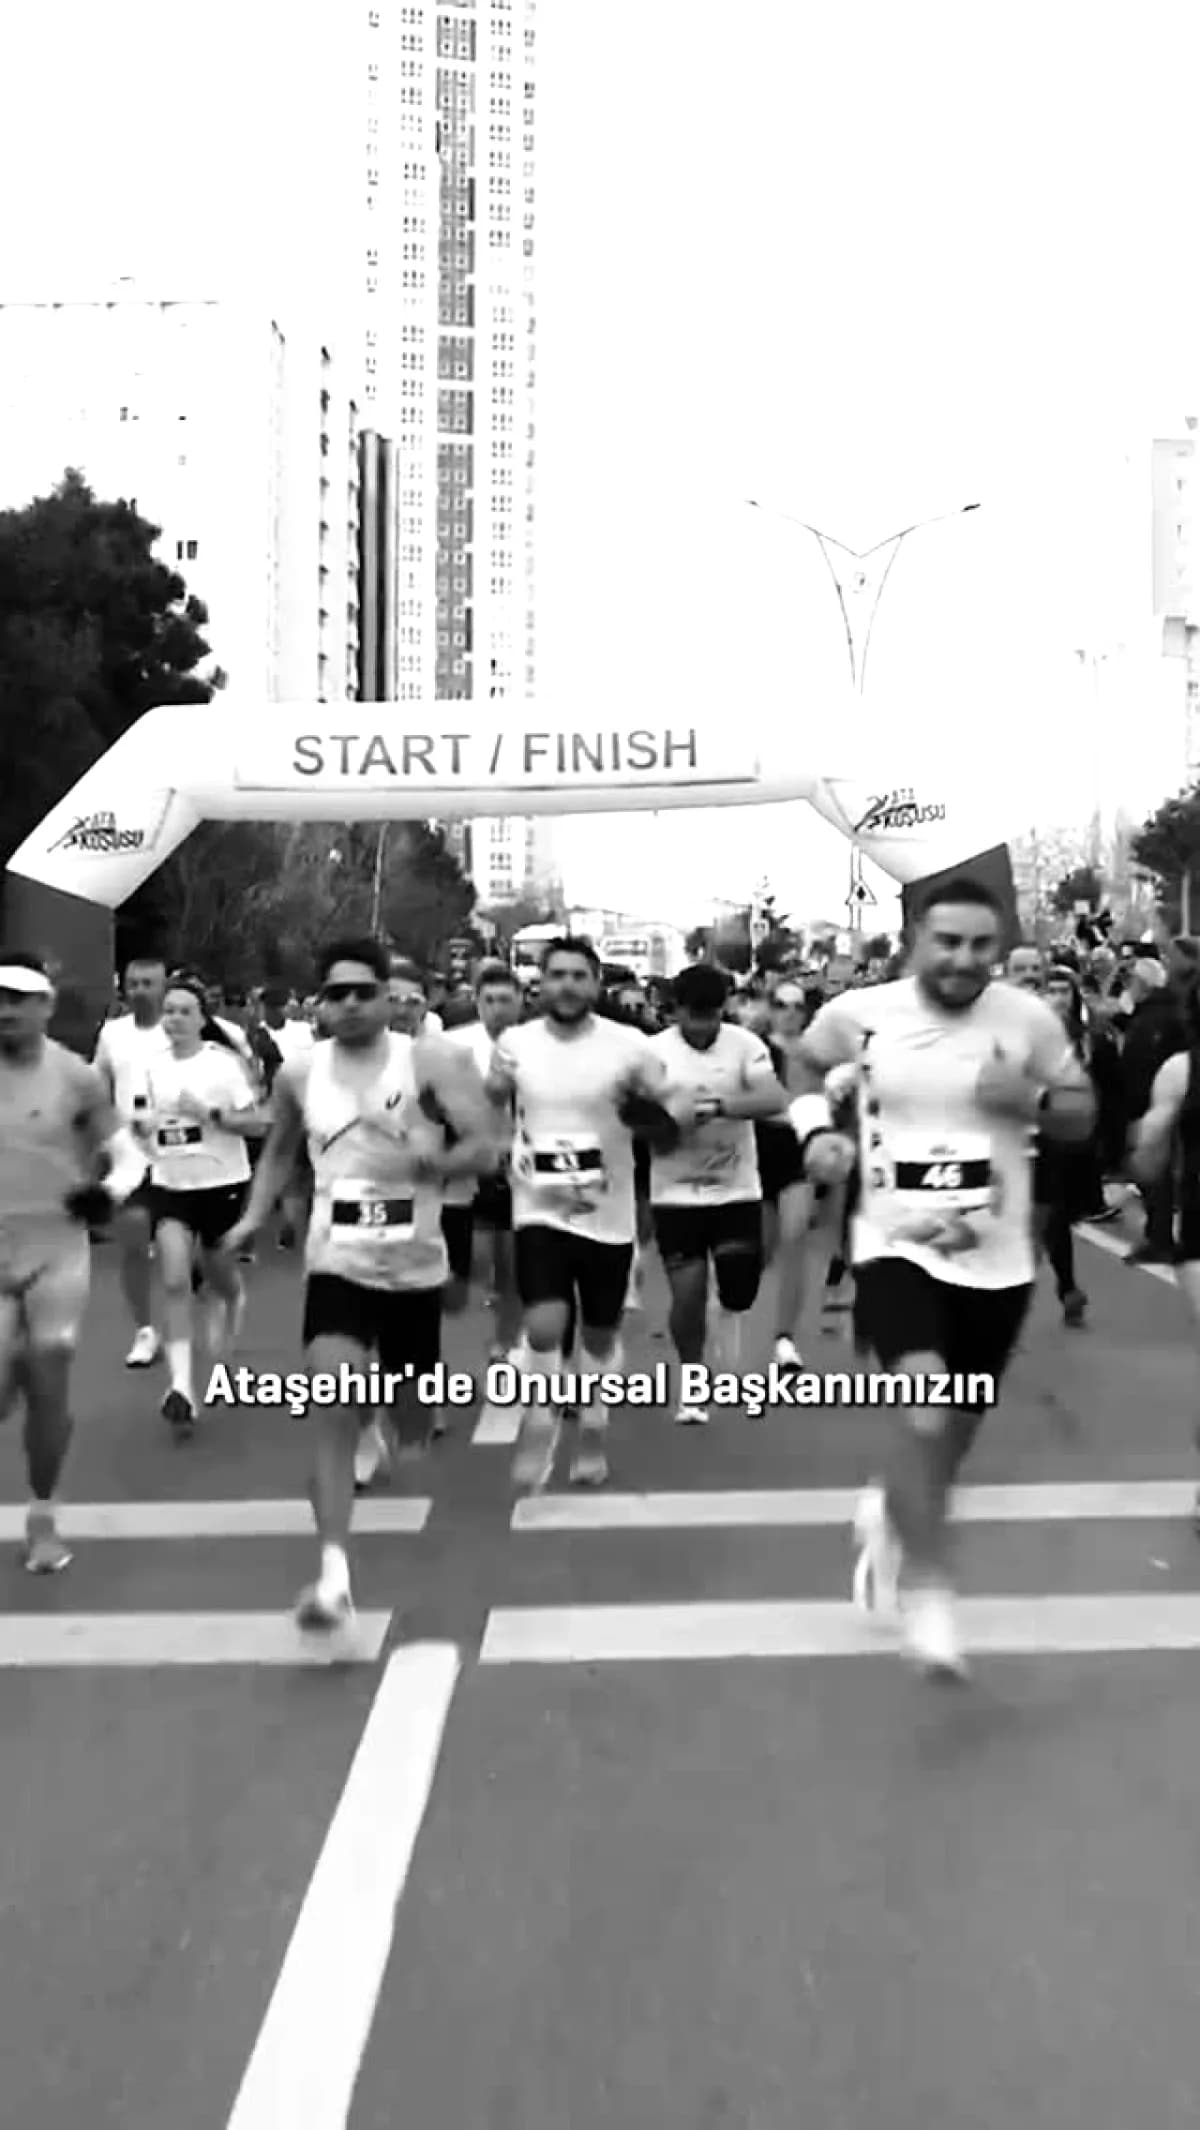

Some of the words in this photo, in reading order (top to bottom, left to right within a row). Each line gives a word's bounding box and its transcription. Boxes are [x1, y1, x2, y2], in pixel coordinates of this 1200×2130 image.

[293, 734, 471, 775] START
[488, 733, 503, 774] /
[523, 728, 697, 773] FINISH
[920, 1163, 963, 1189] 46
